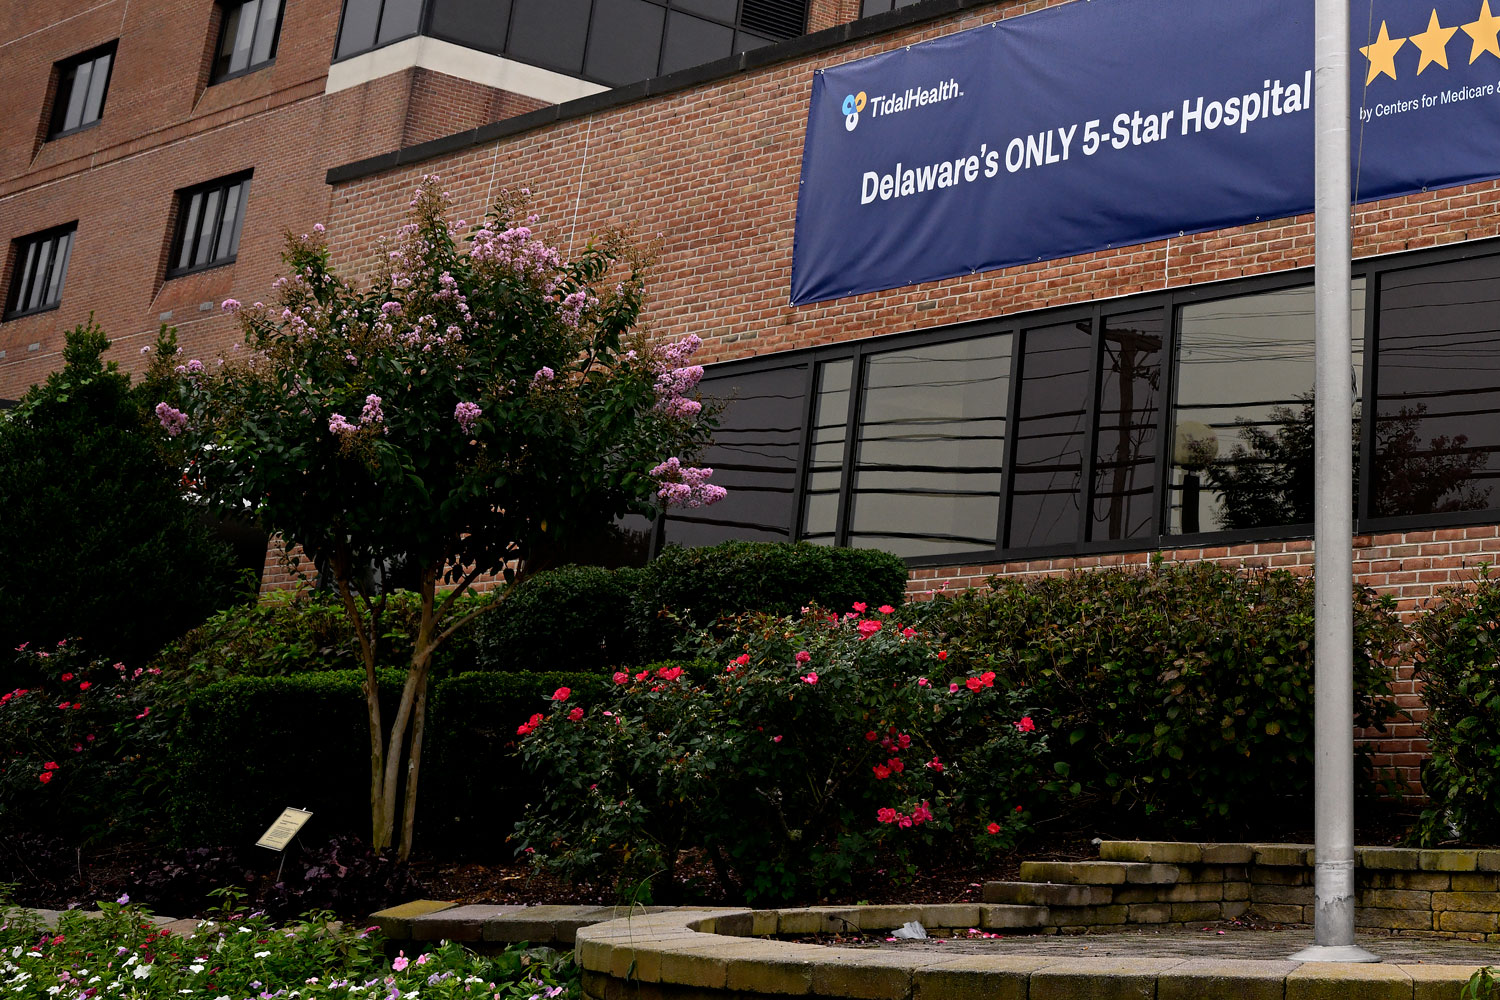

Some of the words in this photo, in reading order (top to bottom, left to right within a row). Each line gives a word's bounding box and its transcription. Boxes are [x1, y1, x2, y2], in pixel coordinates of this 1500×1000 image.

[861, 144, 998, 204] Delaware's
[1005, 124, 1078, 174] ONLY
[1082, 110, 1173, 156] 5-Star
[1181, 70, 1312, 134] Hospital
[1359, 106, 1373, 122] by
[1375, 99, 1419, 117] Centers
[1421, 94, 1438, 108] for
[1440, 84, 1494, 104] Medicare
